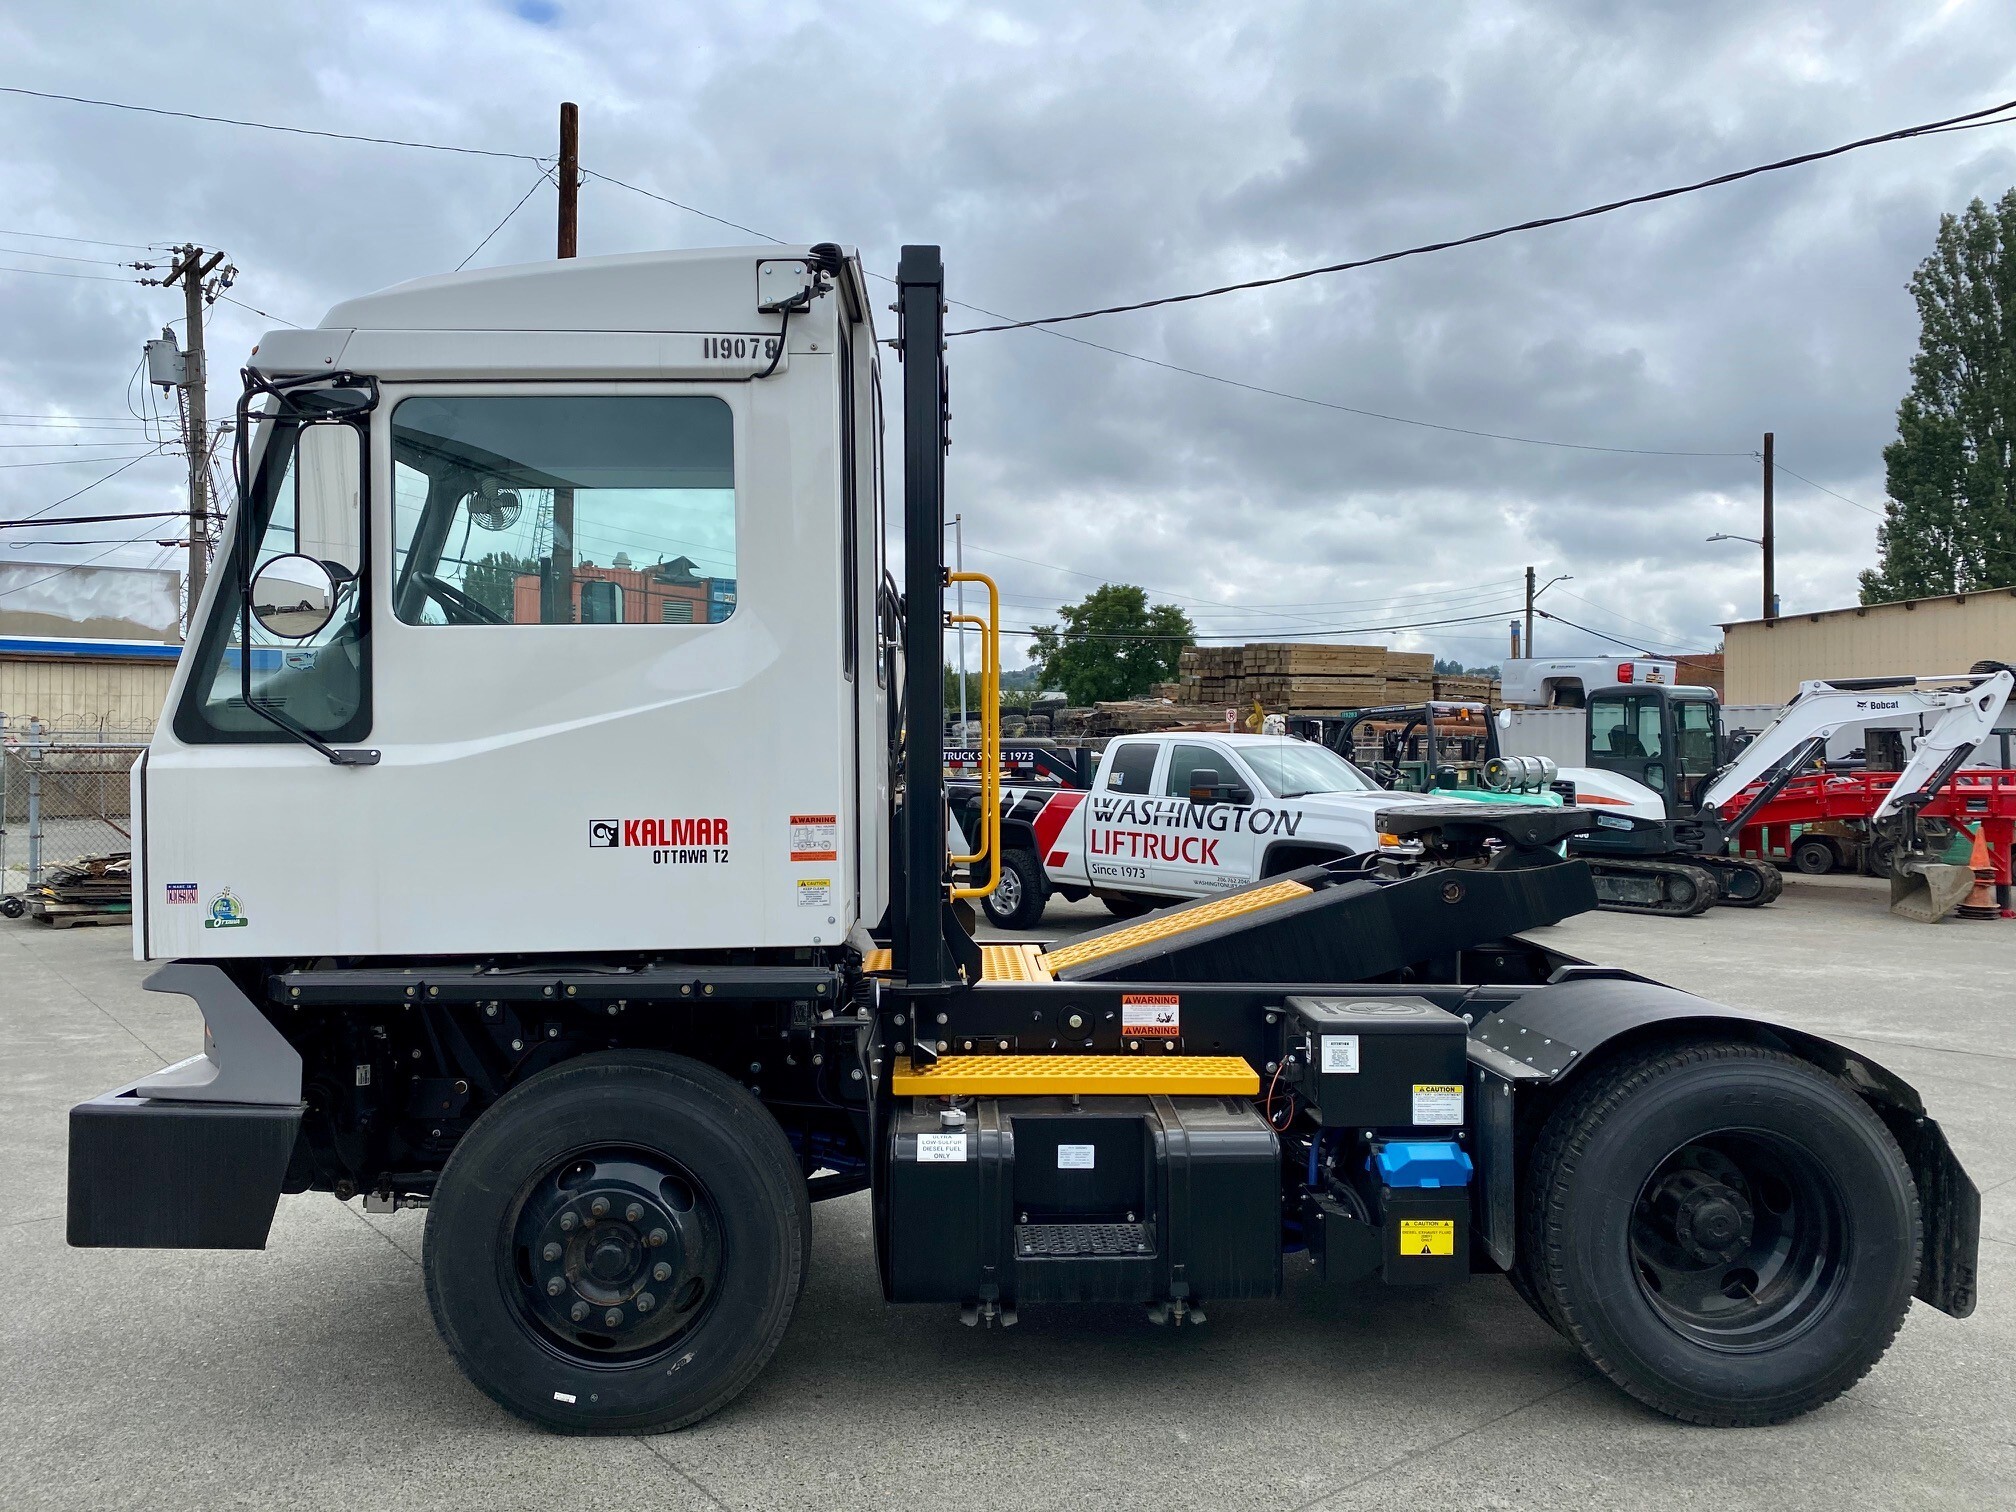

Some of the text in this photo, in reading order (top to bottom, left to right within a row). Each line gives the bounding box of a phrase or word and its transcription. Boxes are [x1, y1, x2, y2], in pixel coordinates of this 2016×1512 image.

[704, 337, 779, 359] 119078
[1870, 701, 1899, 710] Bobcat
[943, 752, 975, 760] TRUCK
[1010, 751, 1034, 760] 1973
[1094, 798, 1303, 836] WASHINGTON
[625, 818, 728, 846] KALMAR
[1091, 829, 1219, 866] LIFTRUCK
[653, 849, 729, 864] OTTAWA T2
[1092, 863, 1146, 879] Since 1973
[1132, 996, 1177, 1004] WARNING
